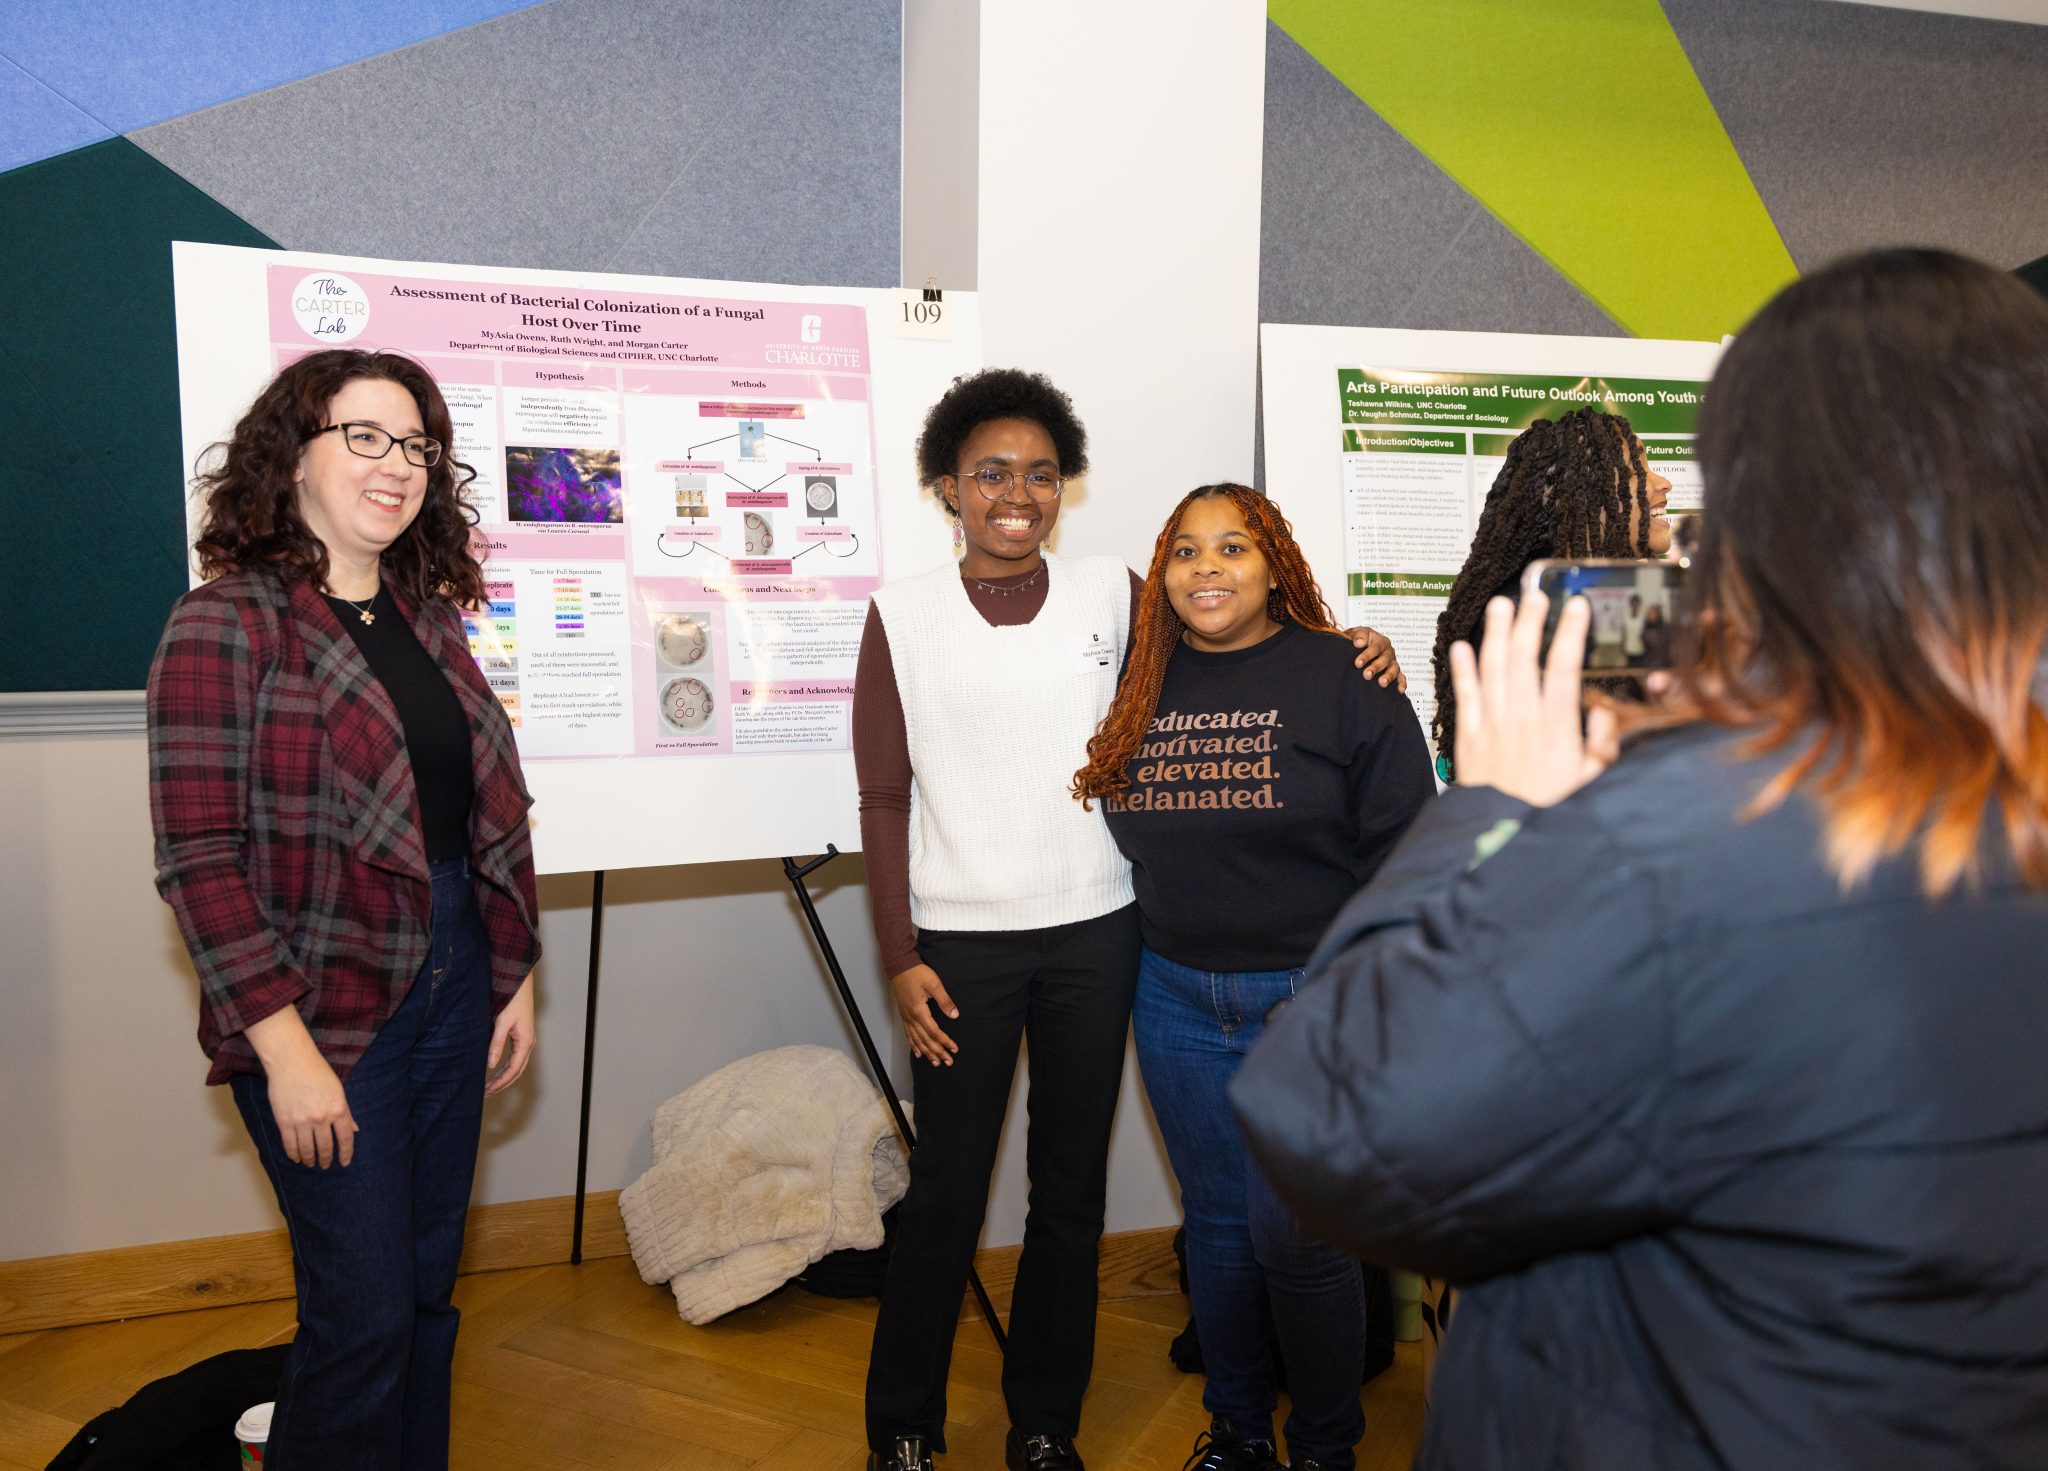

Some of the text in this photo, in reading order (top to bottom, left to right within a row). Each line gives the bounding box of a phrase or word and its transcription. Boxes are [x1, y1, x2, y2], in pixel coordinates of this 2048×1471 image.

[313, 279, 347, 295] The
[296, 297, 366, 316] CARTER
[390, 285, 764, 322] Assessment of Bacterial Colonization of a Fungal
[902, 301, 942, 324] 109
[313, 316, 347, 335] Lab
[522, 313, 642, 333] Host Over Time
[481, 330, 689, 351] MyAsia Owens, Ruth Wright, and Morgan Carter
[449, 340, 504, 351] Department
[516, 345, 560, 356] Biological
[561, 348, 599, 358] Sciences
[600, 351, 616, 359] and
[617, 351, 656, 361] CIPHER,
[658, 353, 677, 361] UNC
[678, 354, 719, 363] Charlotte
[765, 350, 861, 368] CHARLOTTE
[535, 371, 585, 381] Hypothesis
[731, 380, 767, 389] Methods
[1346, 381, 1697, 405] Arts Participation and Future Outlook Among Youth
[520, 403, 562, 412] independently
[1348, 400, 1384, 408] Tashawna
[1384, 401, 1414, 409] Wilkins,
[1434, 402, 1467, 410] Charlotte
[559, 413, 588, 421] negatively
[1360, 411, 1388, 419] Vaughn
[1389, 411, 1422, 420] Schmutz,
[1423, 412, 1465, 421] Department
[1474, 414, 1509, 423] Sociology
[563, 420, 592, 428] efficiency
[1356, 436, 1455, 449] Introduction/Objectives
[1646, 446, 1674, 454] Future
[473, 541, 507, 549] Results
[755, 585, 771, 594] and
[772, 585, 792, 594] Next
[1362, 580, 1421, 590] Methods/Data
[499, 679, 515, 688] days
[788, 687, 804, 695] and
[1147, 709, 1283, 734] educated.
[1137, 755, 1281, 783] elevated.
